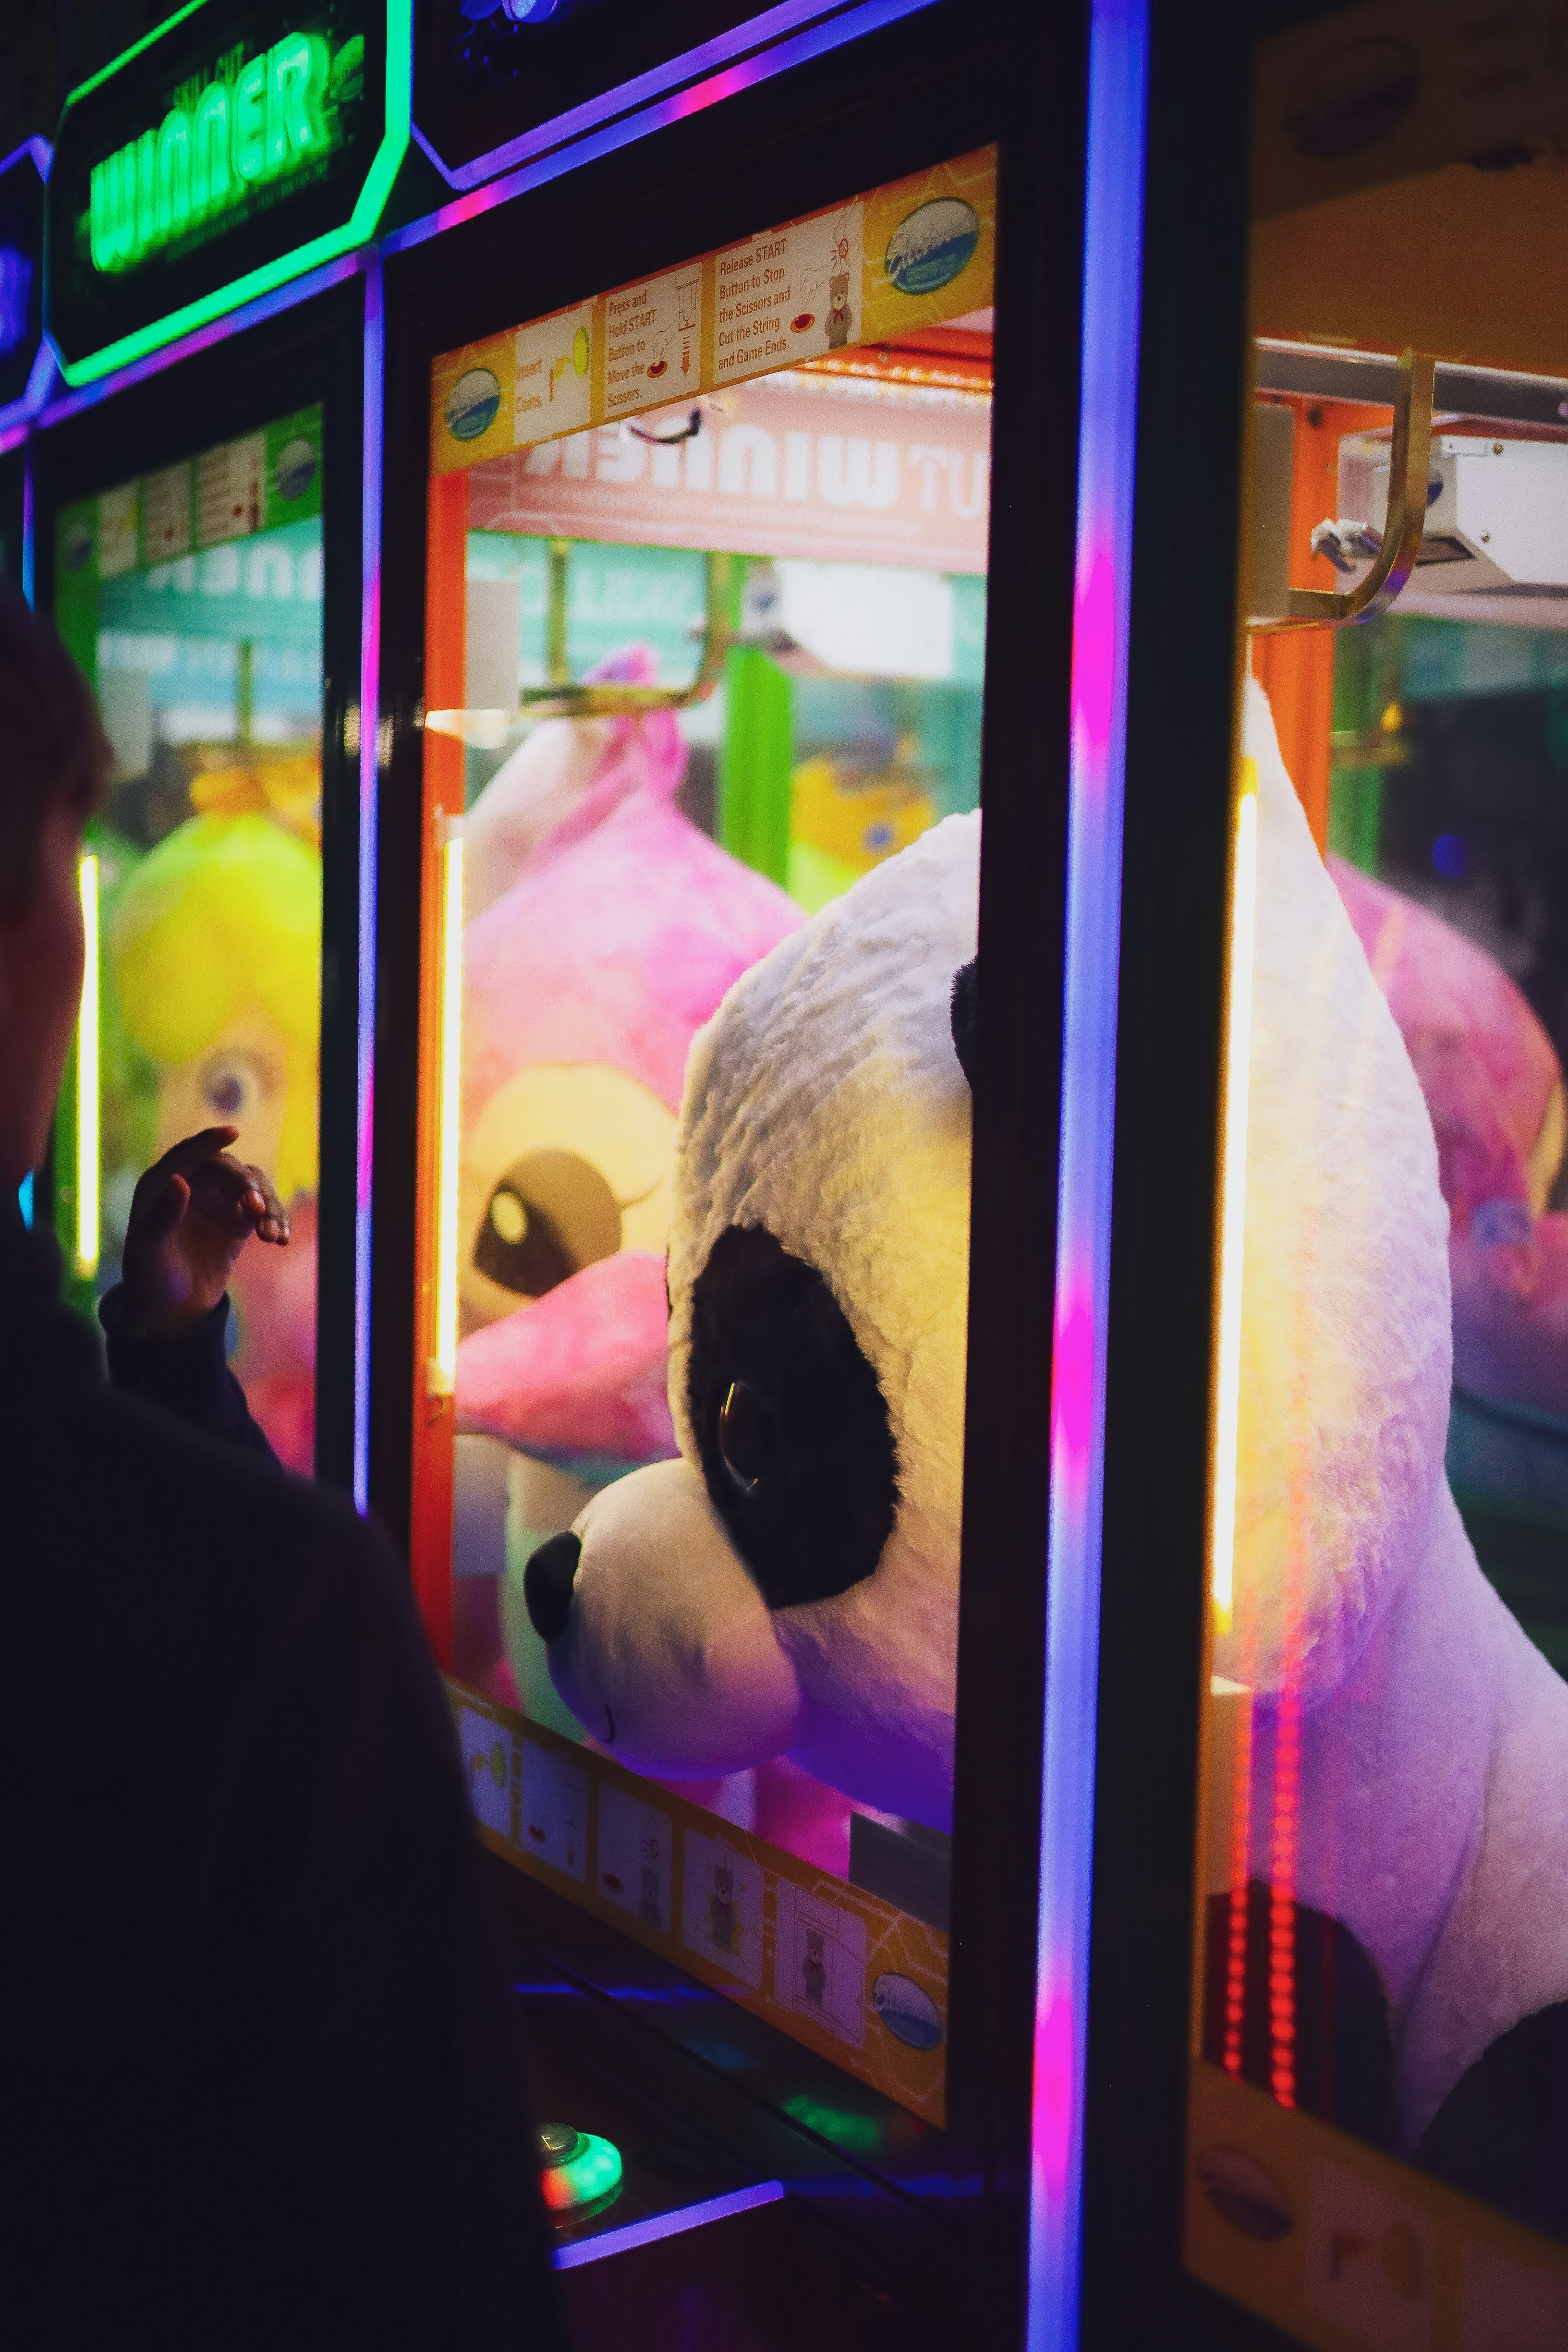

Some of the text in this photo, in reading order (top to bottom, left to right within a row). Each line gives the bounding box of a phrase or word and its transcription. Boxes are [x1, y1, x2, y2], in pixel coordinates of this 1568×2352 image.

[719, 238, 787, 277] Release START
[720, 267, 784, 300] Button to Stop
[608, 289, 647, 316] Press and
[719, 285, 790, 324] the Scissors and
[608, 308, 656, 339] Hold START
[718, 316, 780, 347] Cut the String
[608, 339, 645, 362] Button to
[718, 336, 789, 371] and Game Ends.
[608, 362, 645, 384] Move the
[608, 388, 642, 408] Scissors.
